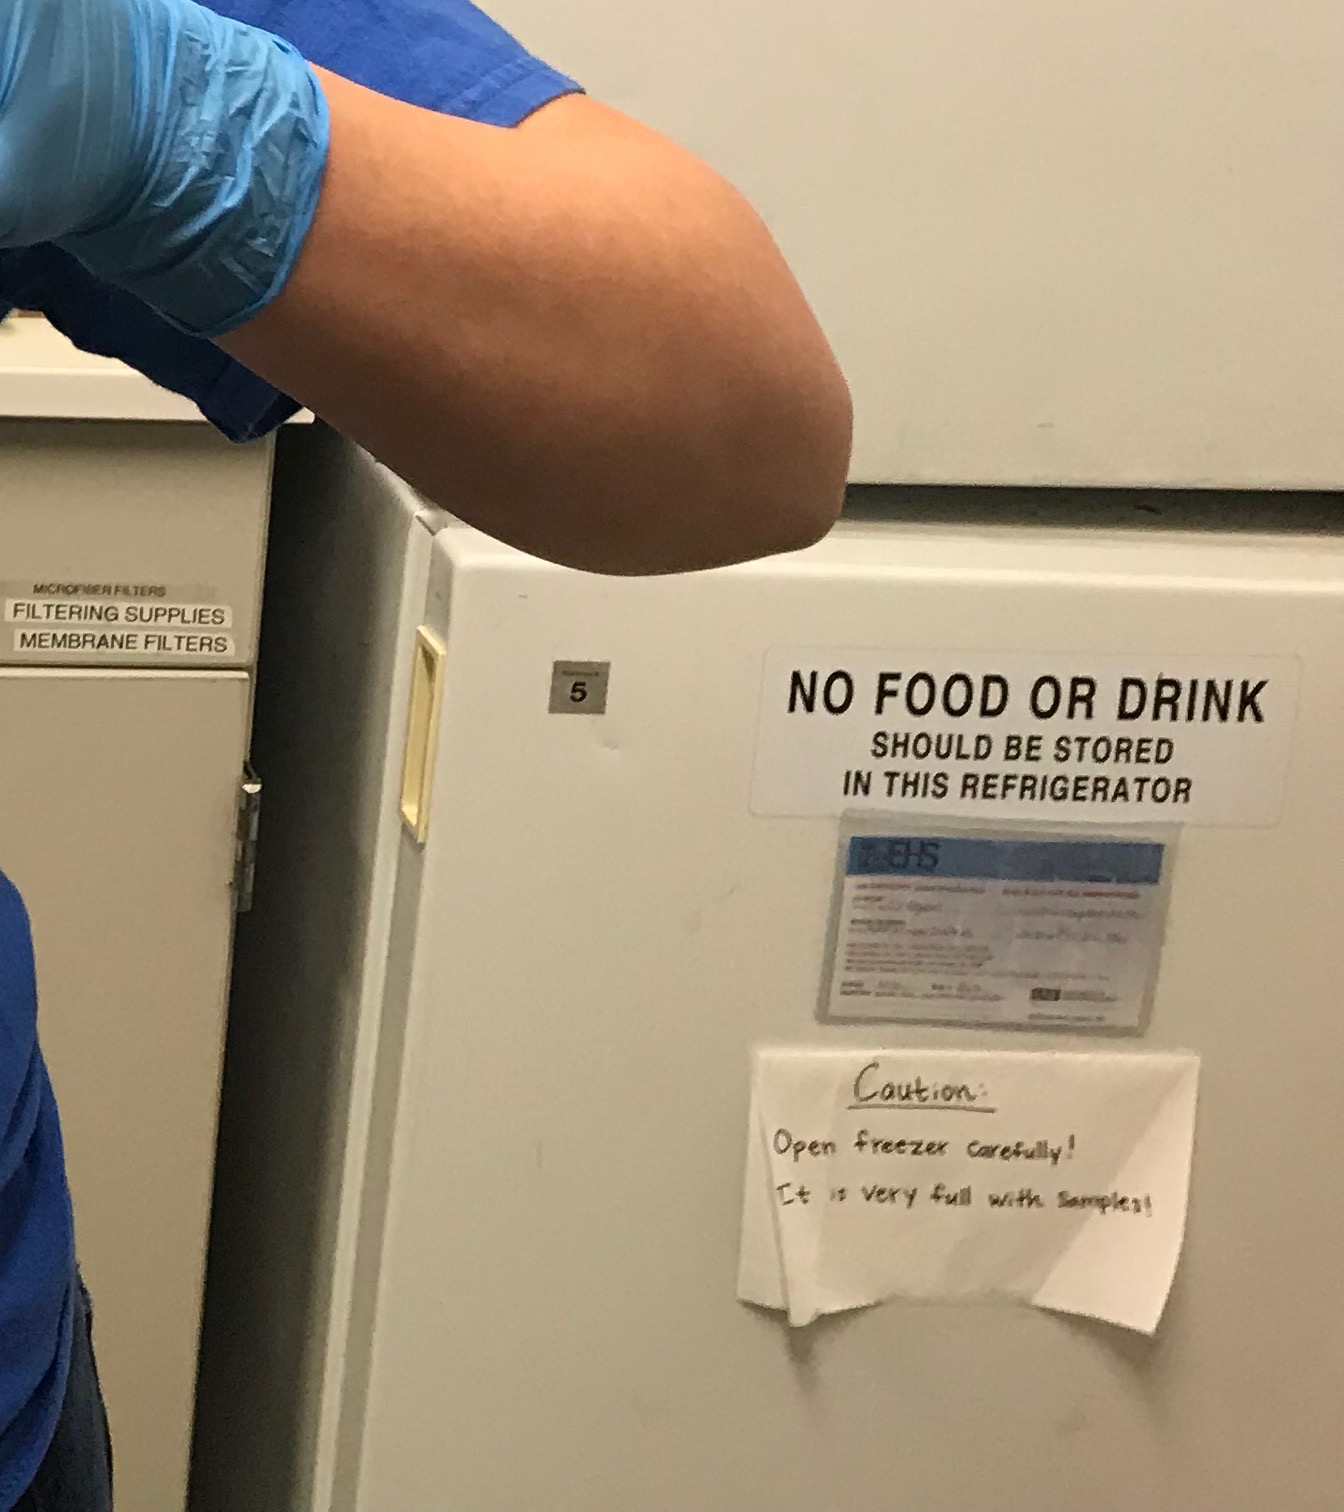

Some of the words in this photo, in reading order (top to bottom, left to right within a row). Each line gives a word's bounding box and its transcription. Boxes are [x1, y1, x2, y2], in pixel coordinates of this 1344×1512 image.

[113, 584, 167, 598] FILTERS
[13, 601, 119, 622] FILTERING
[124, 605, 226, 626] SUPPLIES
[20, 632, 139, 651] MEMBRANE
[143, 634, 229, 654] FILTERS
[569, 681, 588, 703] 5
[788, 669, 854, 715] NO
[875, 671, 1009, 718] FOOD
[1029, 675, 1097, 721] OR
[1117, 675, 1269, 724] DRINK
[871, 731, 993, 761] SHOULD
[1004, 734, 1043, 762] BE
[1054, 735, 1174, 764] STORED
[843, 769, 872, 797] IN
[884, 770, 949, 800] THIS
[960, 772, 1193, 804] REFRIGERATOR
[773, 1127, 837, 1163] Open
[853, 1128, 950, 1157] freezer
[776, 1181, 811, 1206] It
[929, 1182, 972, 1207] full
[987, 1188, 1044, 1209] with
